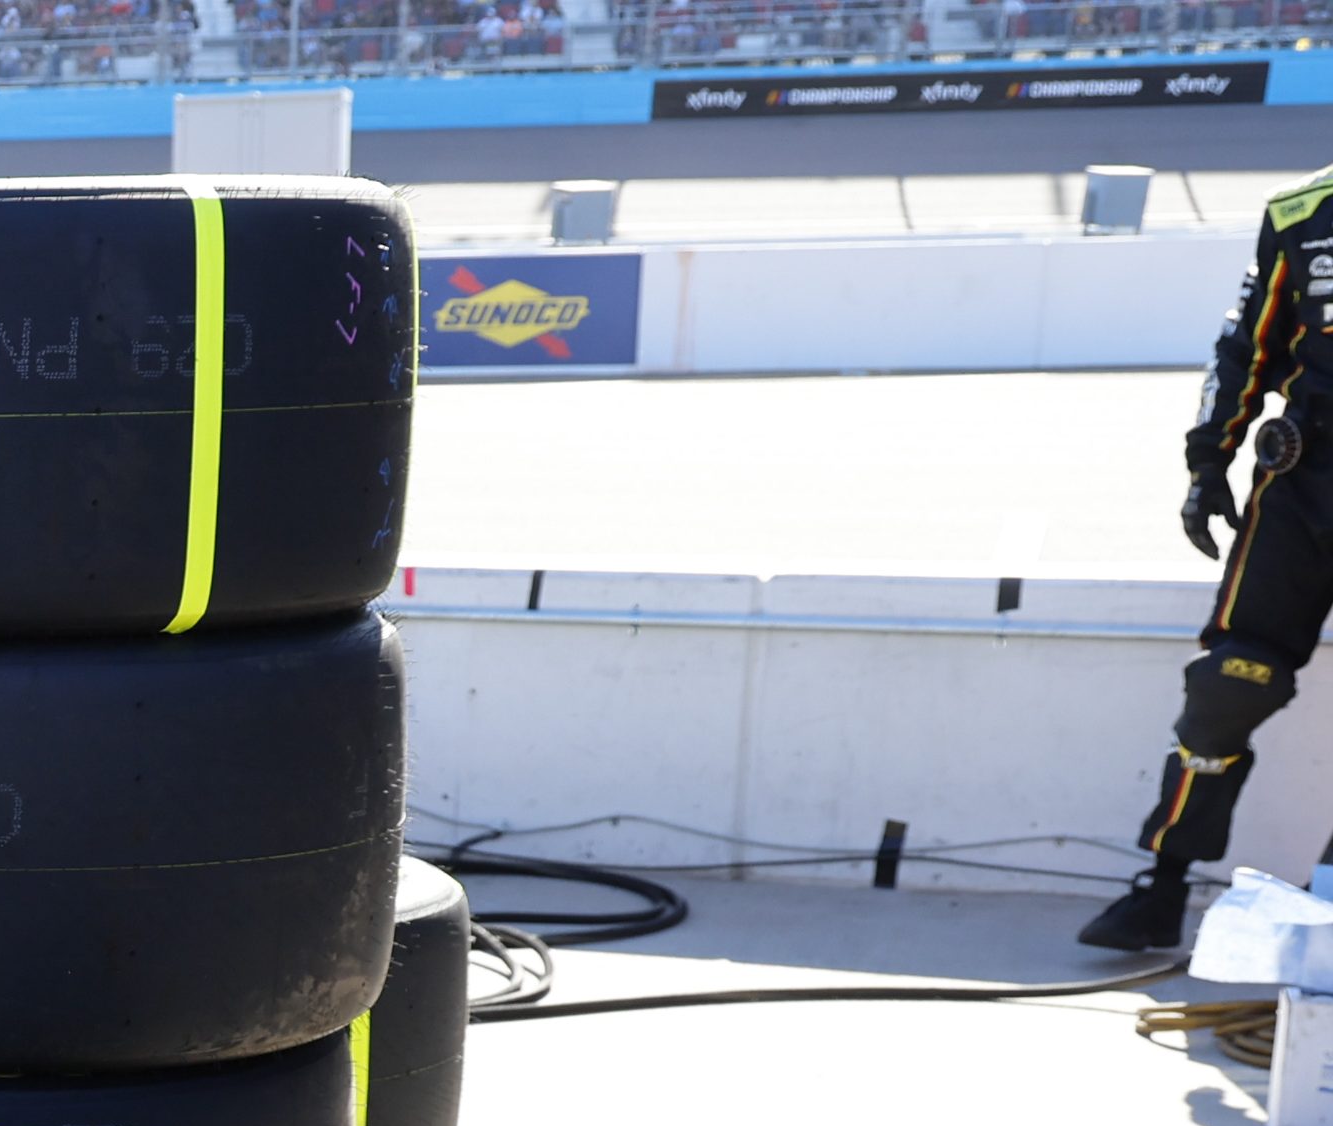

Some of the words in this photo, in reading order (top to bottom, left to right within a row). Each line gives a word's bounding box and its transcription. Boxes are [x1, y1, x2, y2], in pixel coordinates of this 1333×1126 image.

[685, 87, 747, 111] xfinity
[788, 86, 898, 106] CHAMPIONSHIP
[919, 81, 983, 105] xfinity
[1027, 79, 1143, 99] CHAMPIONSHIP
[1164, 73, 1232, 97] xfinity
[443, 301, 580, 327] SUNOCO
